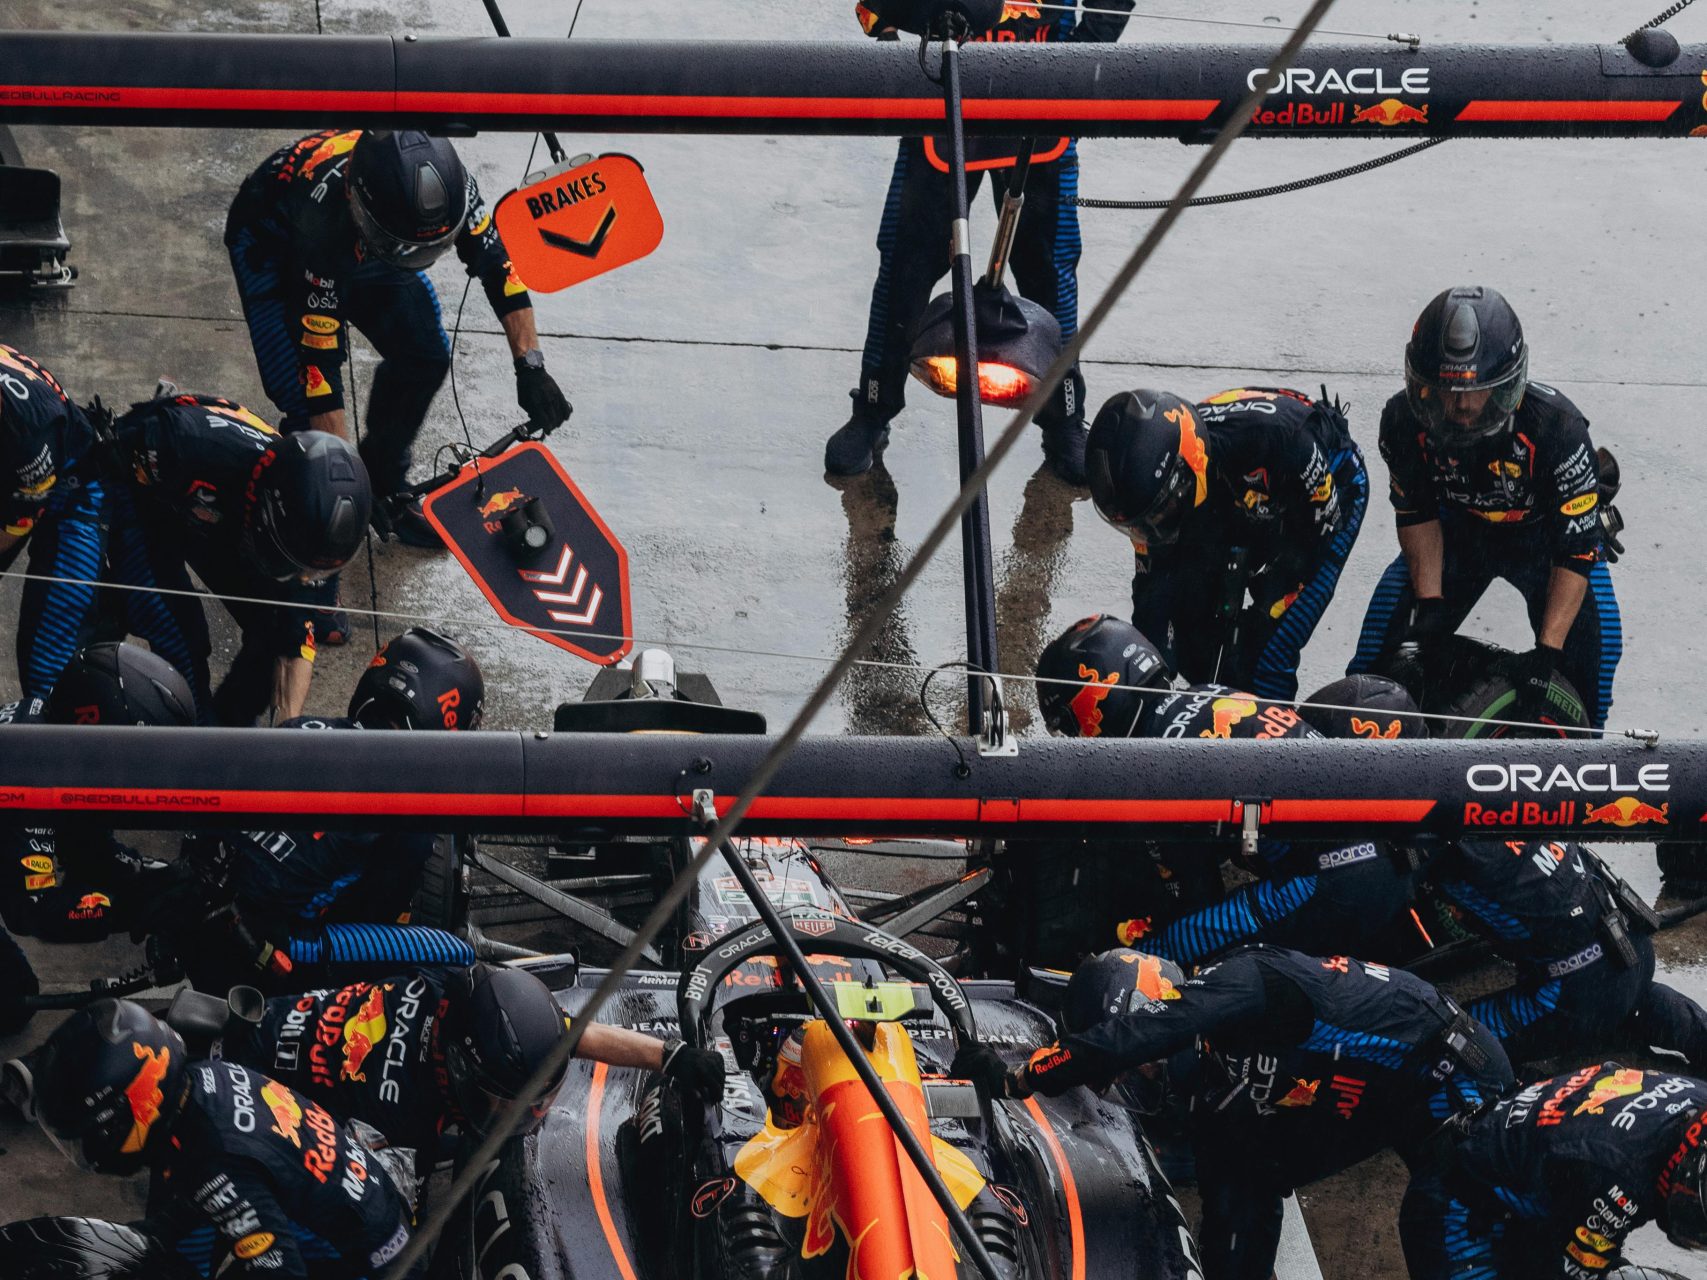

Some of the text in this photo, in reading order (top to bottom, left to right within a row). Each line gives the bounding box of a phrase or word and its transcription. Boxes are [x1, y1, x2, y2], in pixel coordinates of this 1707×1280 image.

[1246, 67, 1431, 95] ORACLE
[1296, 102, 1345, 125] Bull
[526, 172, 607, 220] BRAKES
[305, 268, 335, 289] Mobil
[1199, 400, 1277, 416] ORAC
[483, 519, 504, 536] Re
[436, 687, 462, 731] Re
[1466, 763, 1671, 792] ORACLE
[60, 792, 221, 807] @REDBULLRACING
[1463, 800, 1576, 826] Red Bull
[1318, 842, 1378, 869] sparco
[794, 920, 834, 934] HEUER
[718, 928, 774, 960] ORACLE
[863, 931, 926, 960] telcel
[1548, 943, 1604, 977] sparco
[684, 964, 712, 1001] BYBIT
[928, 971, 966, 1010] zoom
[378, 975, 427, 1105] ORACLE
[630, 1021, 681, 1032] JEAN
[977, 1033, 1030, 1044] EANS
[1034, 1048, 1073, 1075] Red Bull
[1611, 1076, 1696, 1132] ORACLE
[1593, 1197, 1625, 1230] Claro
[1607, 1184, 1639, 1217] Mobil
